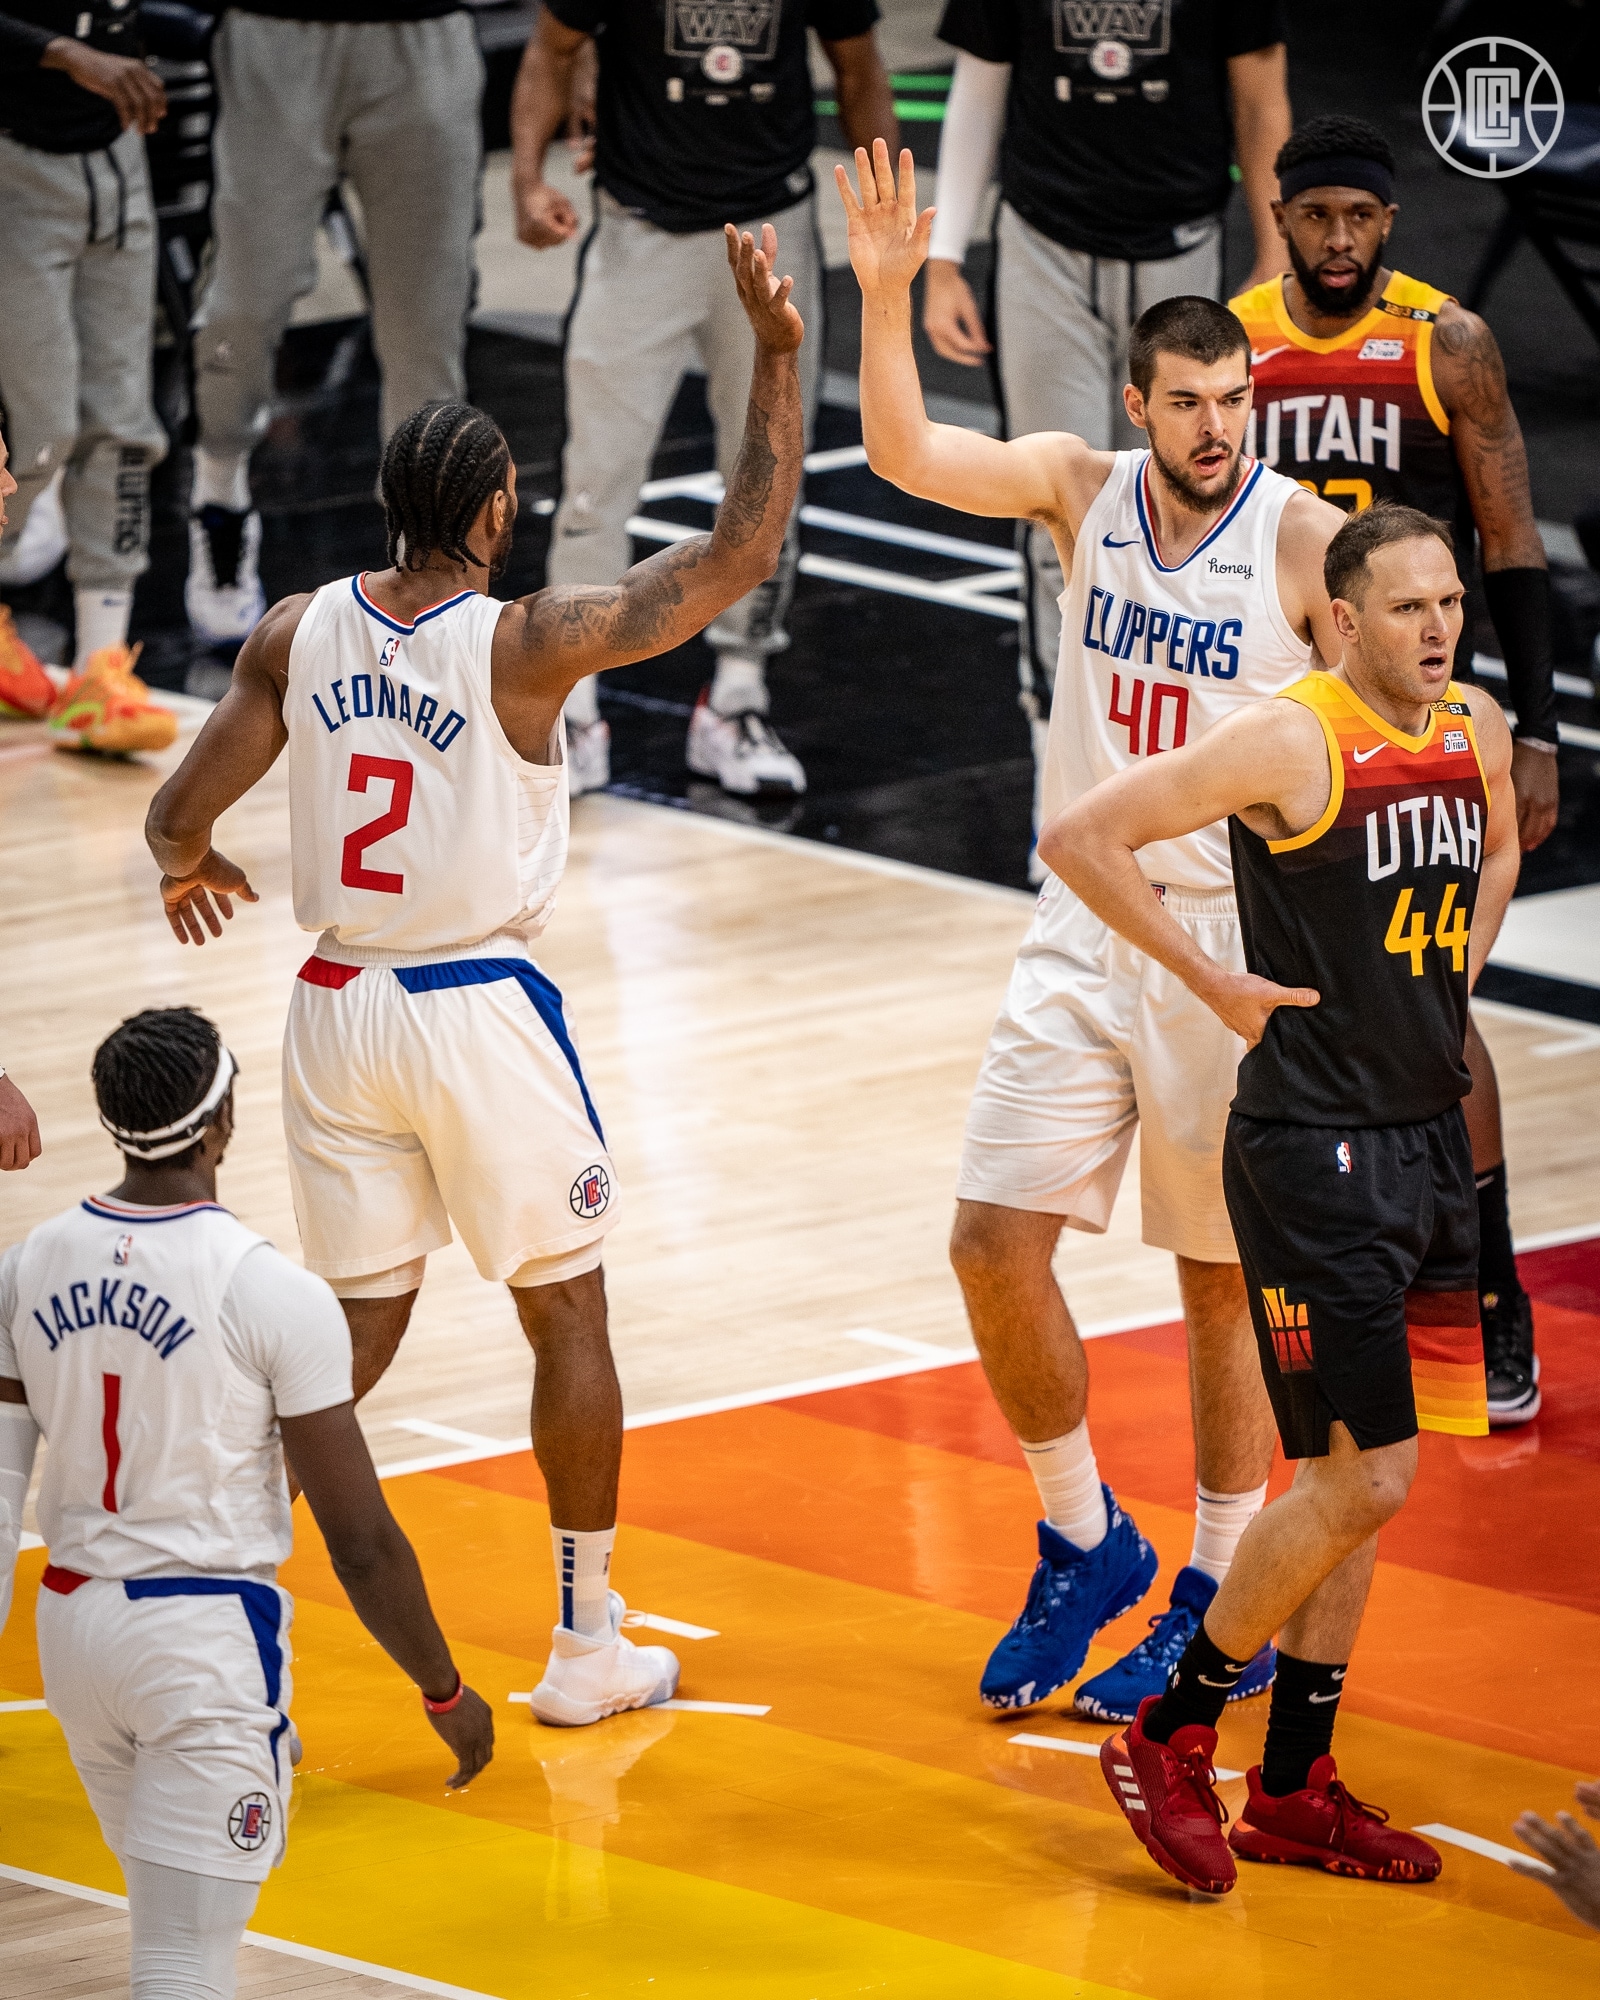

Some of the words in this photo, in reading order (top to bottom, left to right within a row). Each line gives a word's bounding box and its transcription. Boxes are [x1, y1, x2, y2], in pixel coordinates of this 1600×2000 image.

[677, 4, 772, 45] WAY
[1062, 0, 1160, 40] WAY
[1245, 394, 1400, 472] UTAH
[1208, 557, 1254, 580] honey
[1083, 585, 1243, 680] CLIPPERS
[312, 674, 467, 753] LEONARD
[1109, 672, 1189, 756] 40
[1444, 734, 1451, 751] 5
[1448, 703, 1463, 715] 53
[1452, 741, 1467, 750] FIGHT
[341, 753, 414, 894] 2
[1366, 795, 1481, 882] UTAH
[1384, 882, 1470, 977] 44
[33, 1277, 195, 1360] JACKSON
[102, 1371, 121, 1514] 1
